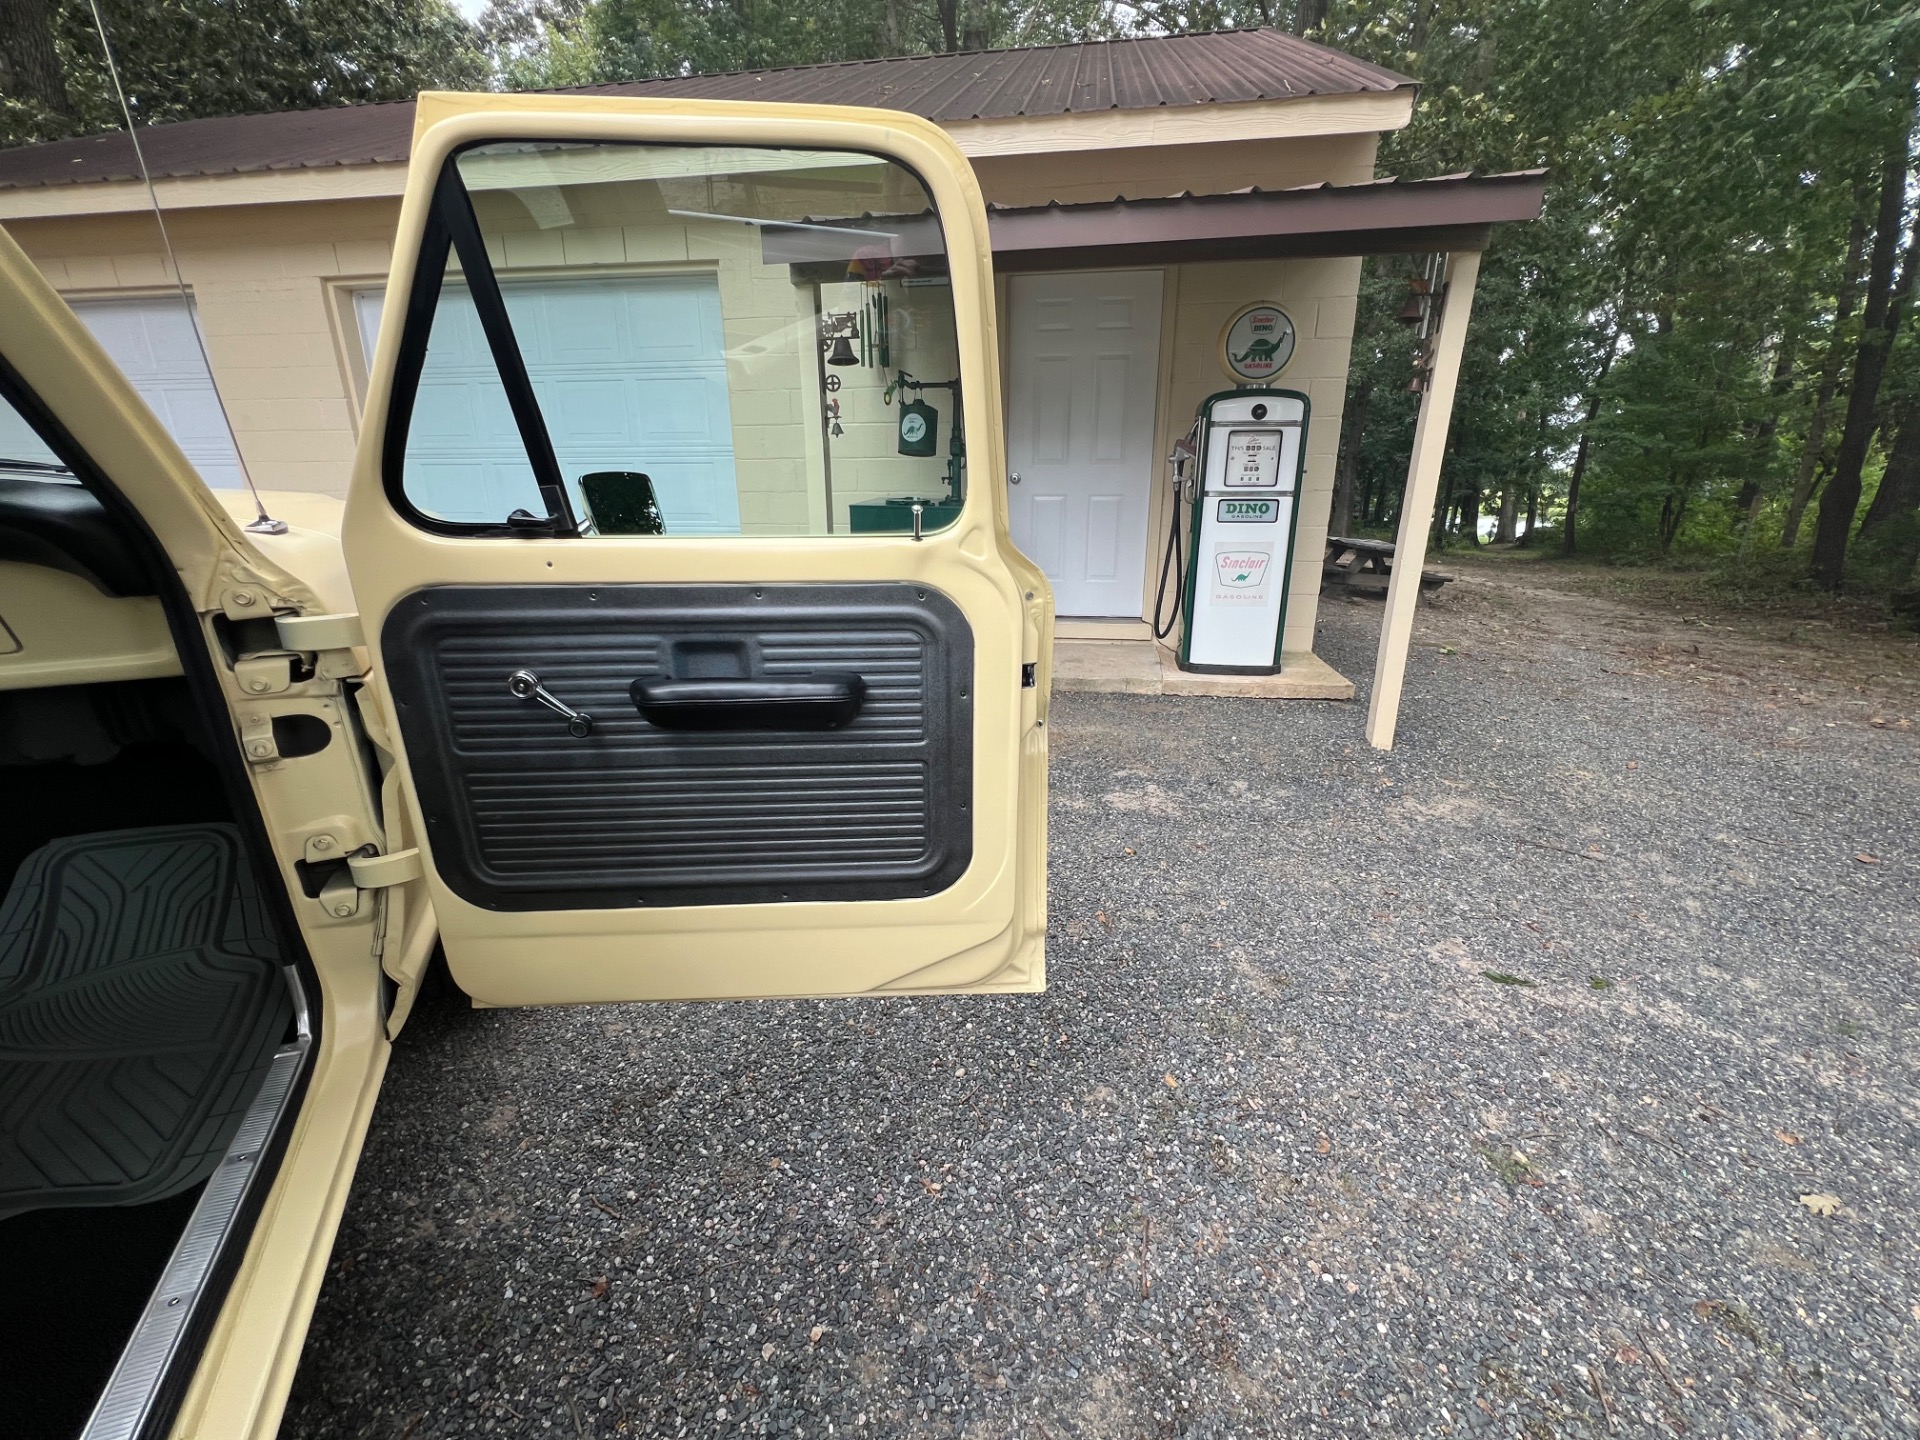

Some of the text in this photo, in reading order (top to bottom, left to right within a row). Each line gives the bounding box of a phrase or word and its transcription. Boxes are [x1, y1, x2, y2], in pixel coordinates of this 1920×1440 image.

[1253, 324, 1273, 332] DINO
[1225, 503, 1270, 514] DINO
[1220, 556, 1266, 569] Sinclair
